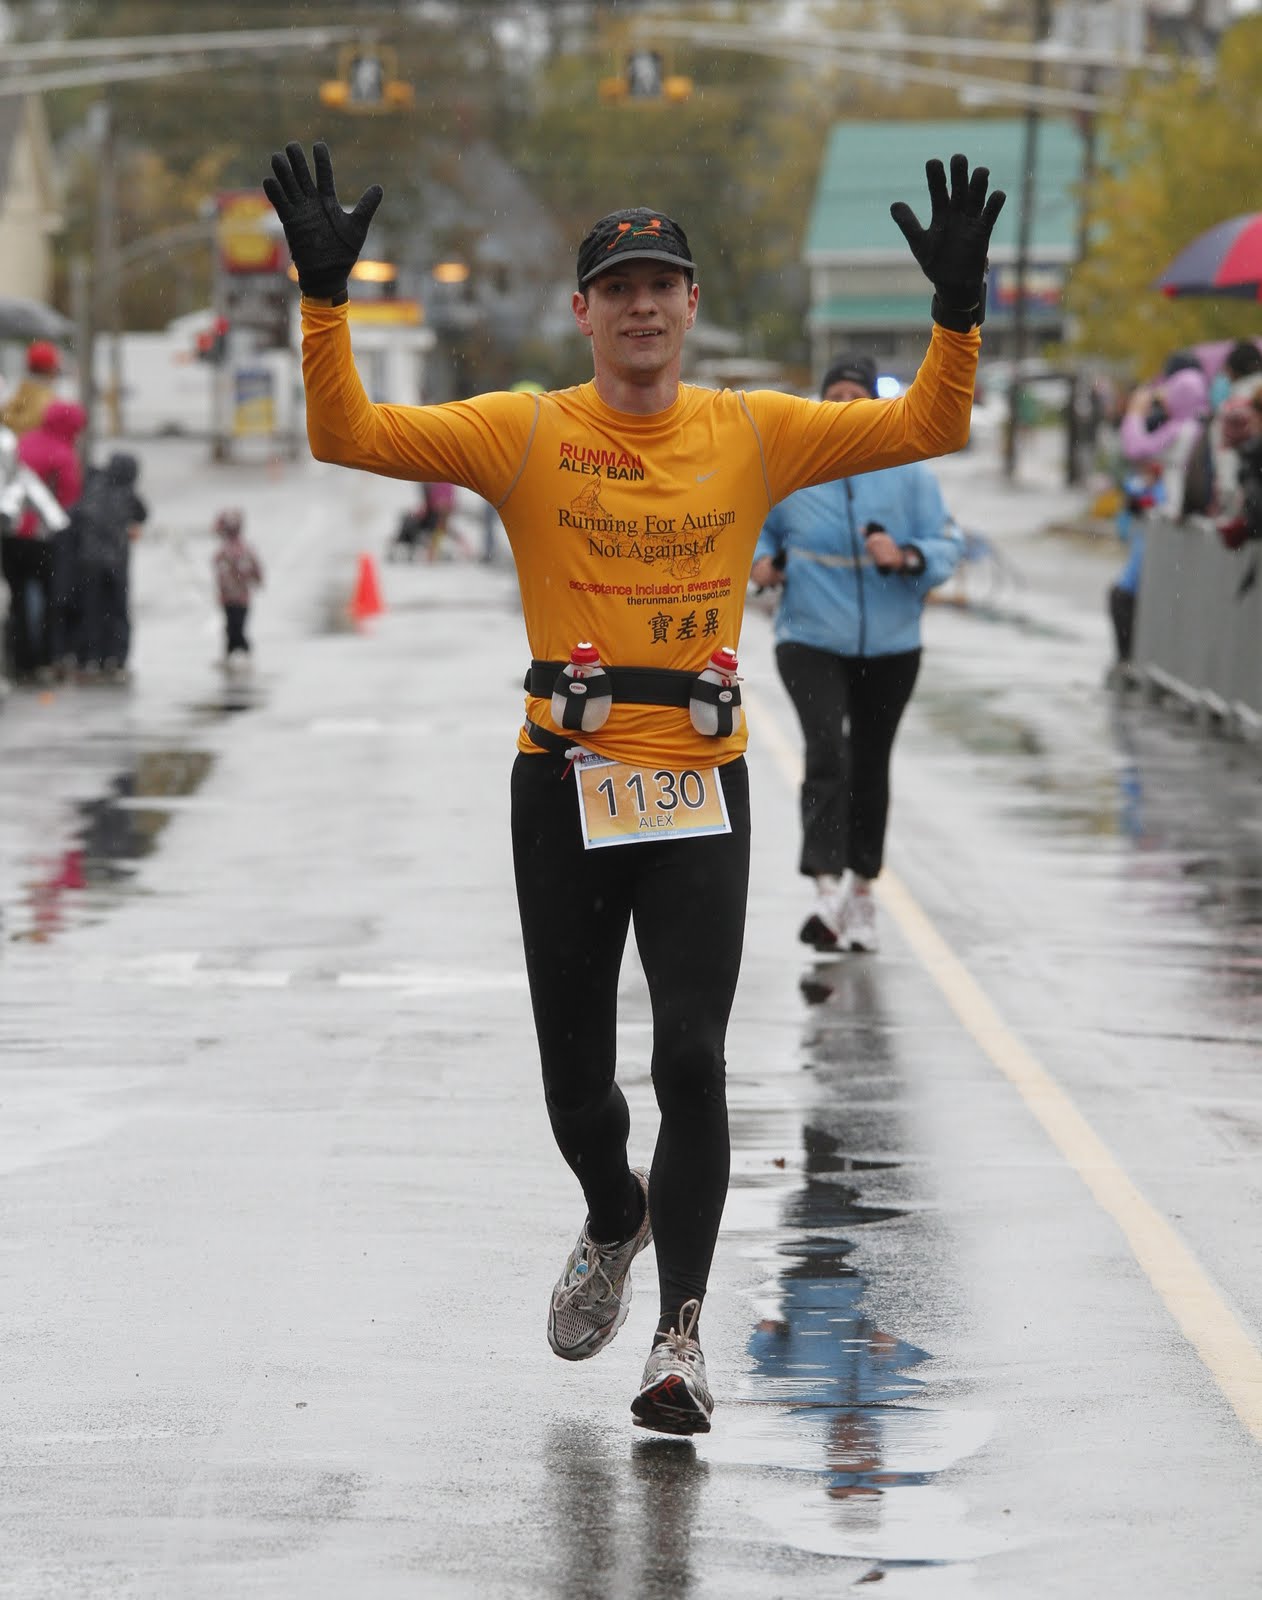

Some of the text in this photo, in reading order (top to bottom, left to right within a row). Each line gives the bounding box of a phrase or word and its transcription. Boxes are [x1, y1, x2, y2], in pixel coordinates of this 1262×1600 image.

[559, 442, 643, 469] RUNMAN
[558, 457, 645, 481] ALEX BAIN
[557, 508, 736, 536] Running For Autism
[587, 535, 716, 563] Not Against It
[569, 577, 731, 596] acceptance inclusion awareness
[627, 589, 731, 606] therunman.blogspot.com
[596, 770, 706, 818] 1130
[639, 814, 674, 829] ALEX
